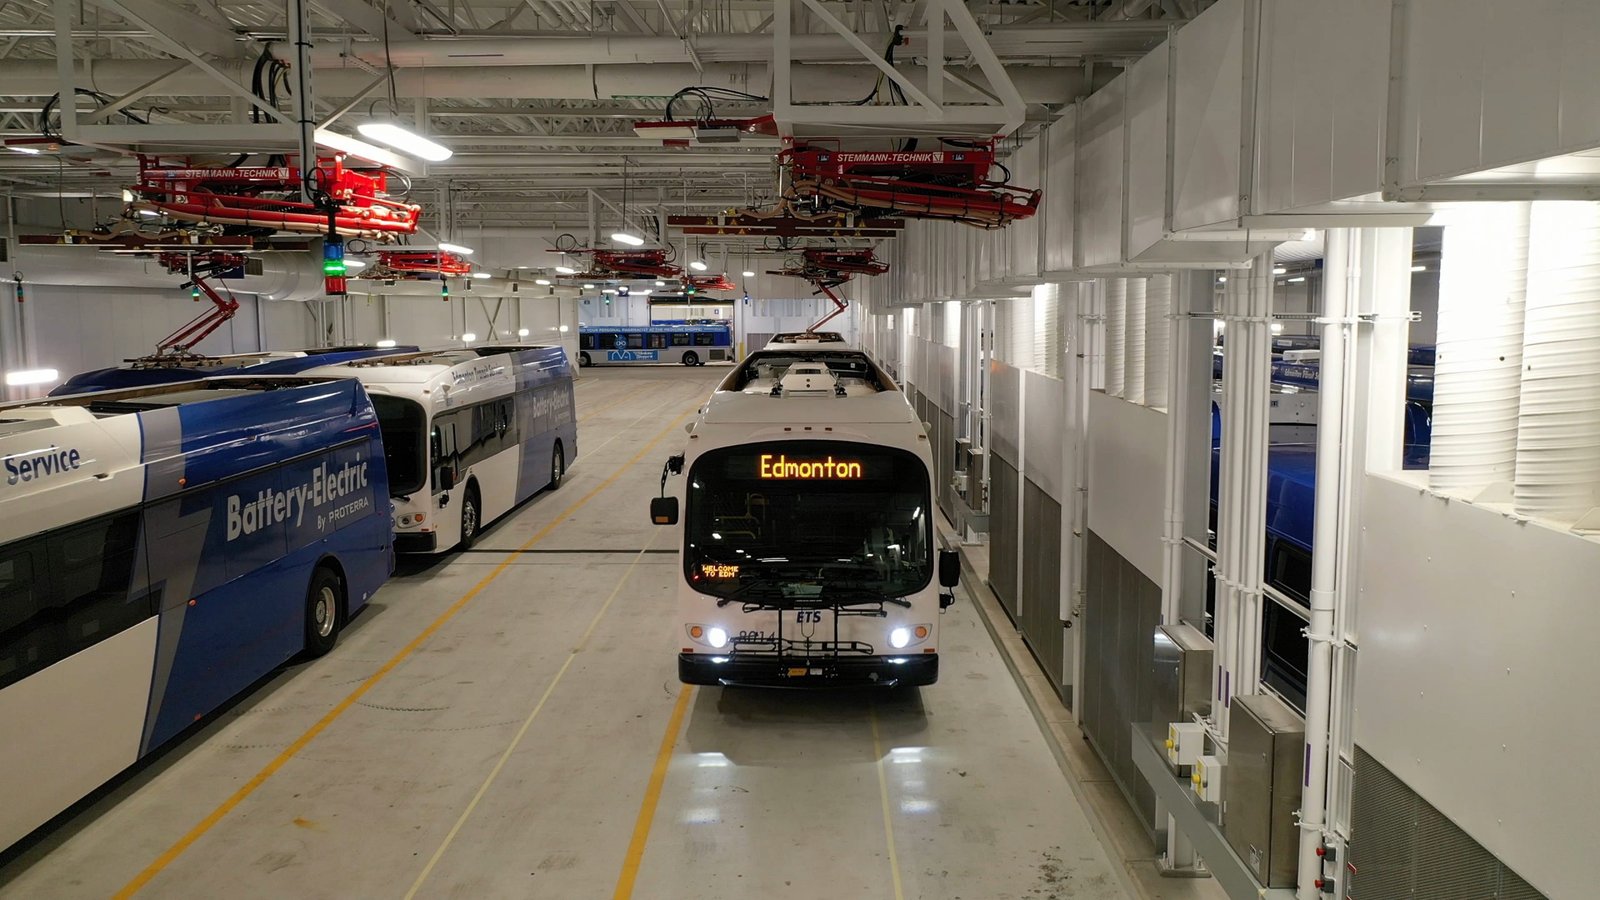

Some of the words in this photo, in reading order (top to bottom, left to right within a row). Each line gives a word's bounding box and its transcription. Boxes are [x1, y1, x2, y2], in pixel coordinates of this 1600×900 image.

[837, 152, 932, 163] STEMMANN-TECHNIK
[4, 444, 81, 486] Service
[760, 454, 861, 479] Edmonton
[226, 452, 368, 542] Battery-Electric
[316, 515, 327, 533] By
[328, 496, 370, 522] PROTERRA
[796, 611, 821, 624] ETS
